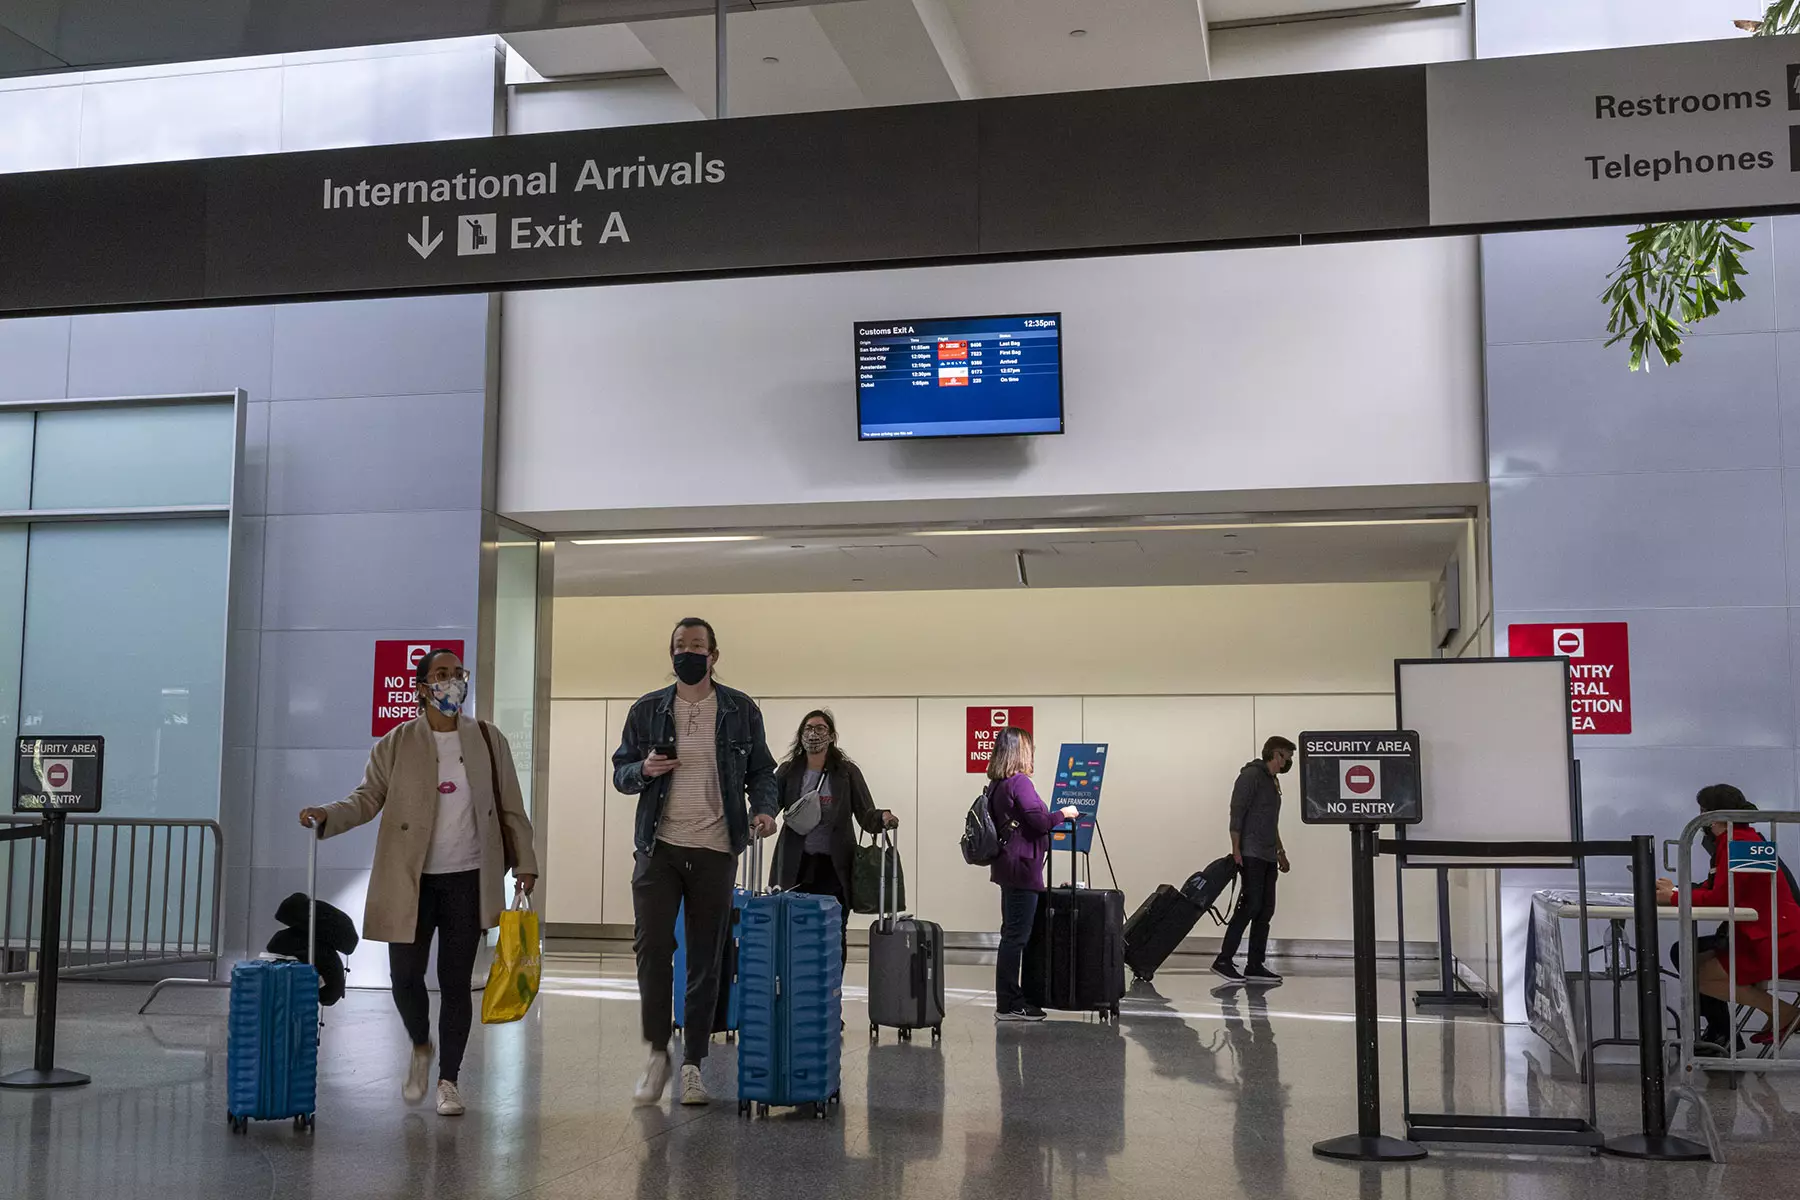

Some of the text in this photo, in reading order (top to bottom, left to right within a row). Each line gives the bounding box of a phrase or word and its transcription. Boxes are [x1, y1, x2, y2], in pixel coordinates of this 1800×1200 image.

[1595, 89, 1772, 119] Restrooms
[1584, 150, 1774, 182] Telephones
[322, 151, 726, 209] International Arrivals
[510, 211, 630, 249] Exit A
[1024, 319, 1056, 328] 12:35pm
[859, 326, 915, 336] Customs Exit A
[1569, 664, 1614, 678] NTRY
[384, 676, 404, 688] NO
[1571, 699, 1623, 713] CTION
[1572, 716, 1596, 730] EA
[974, 730, 990, 740] NO
[20, 744, 97, 753] SECURITY AREA
[1306, 741, 1412, 752] SECURITY AREA
[32, 794, 82, 804] NO ENTRY
[1056, 797, 1096, 806] SAN FRANCISCO
[1327, 802, 1395, 814] NO ENTRY
[1750, 845, 1775, 855] SFO
